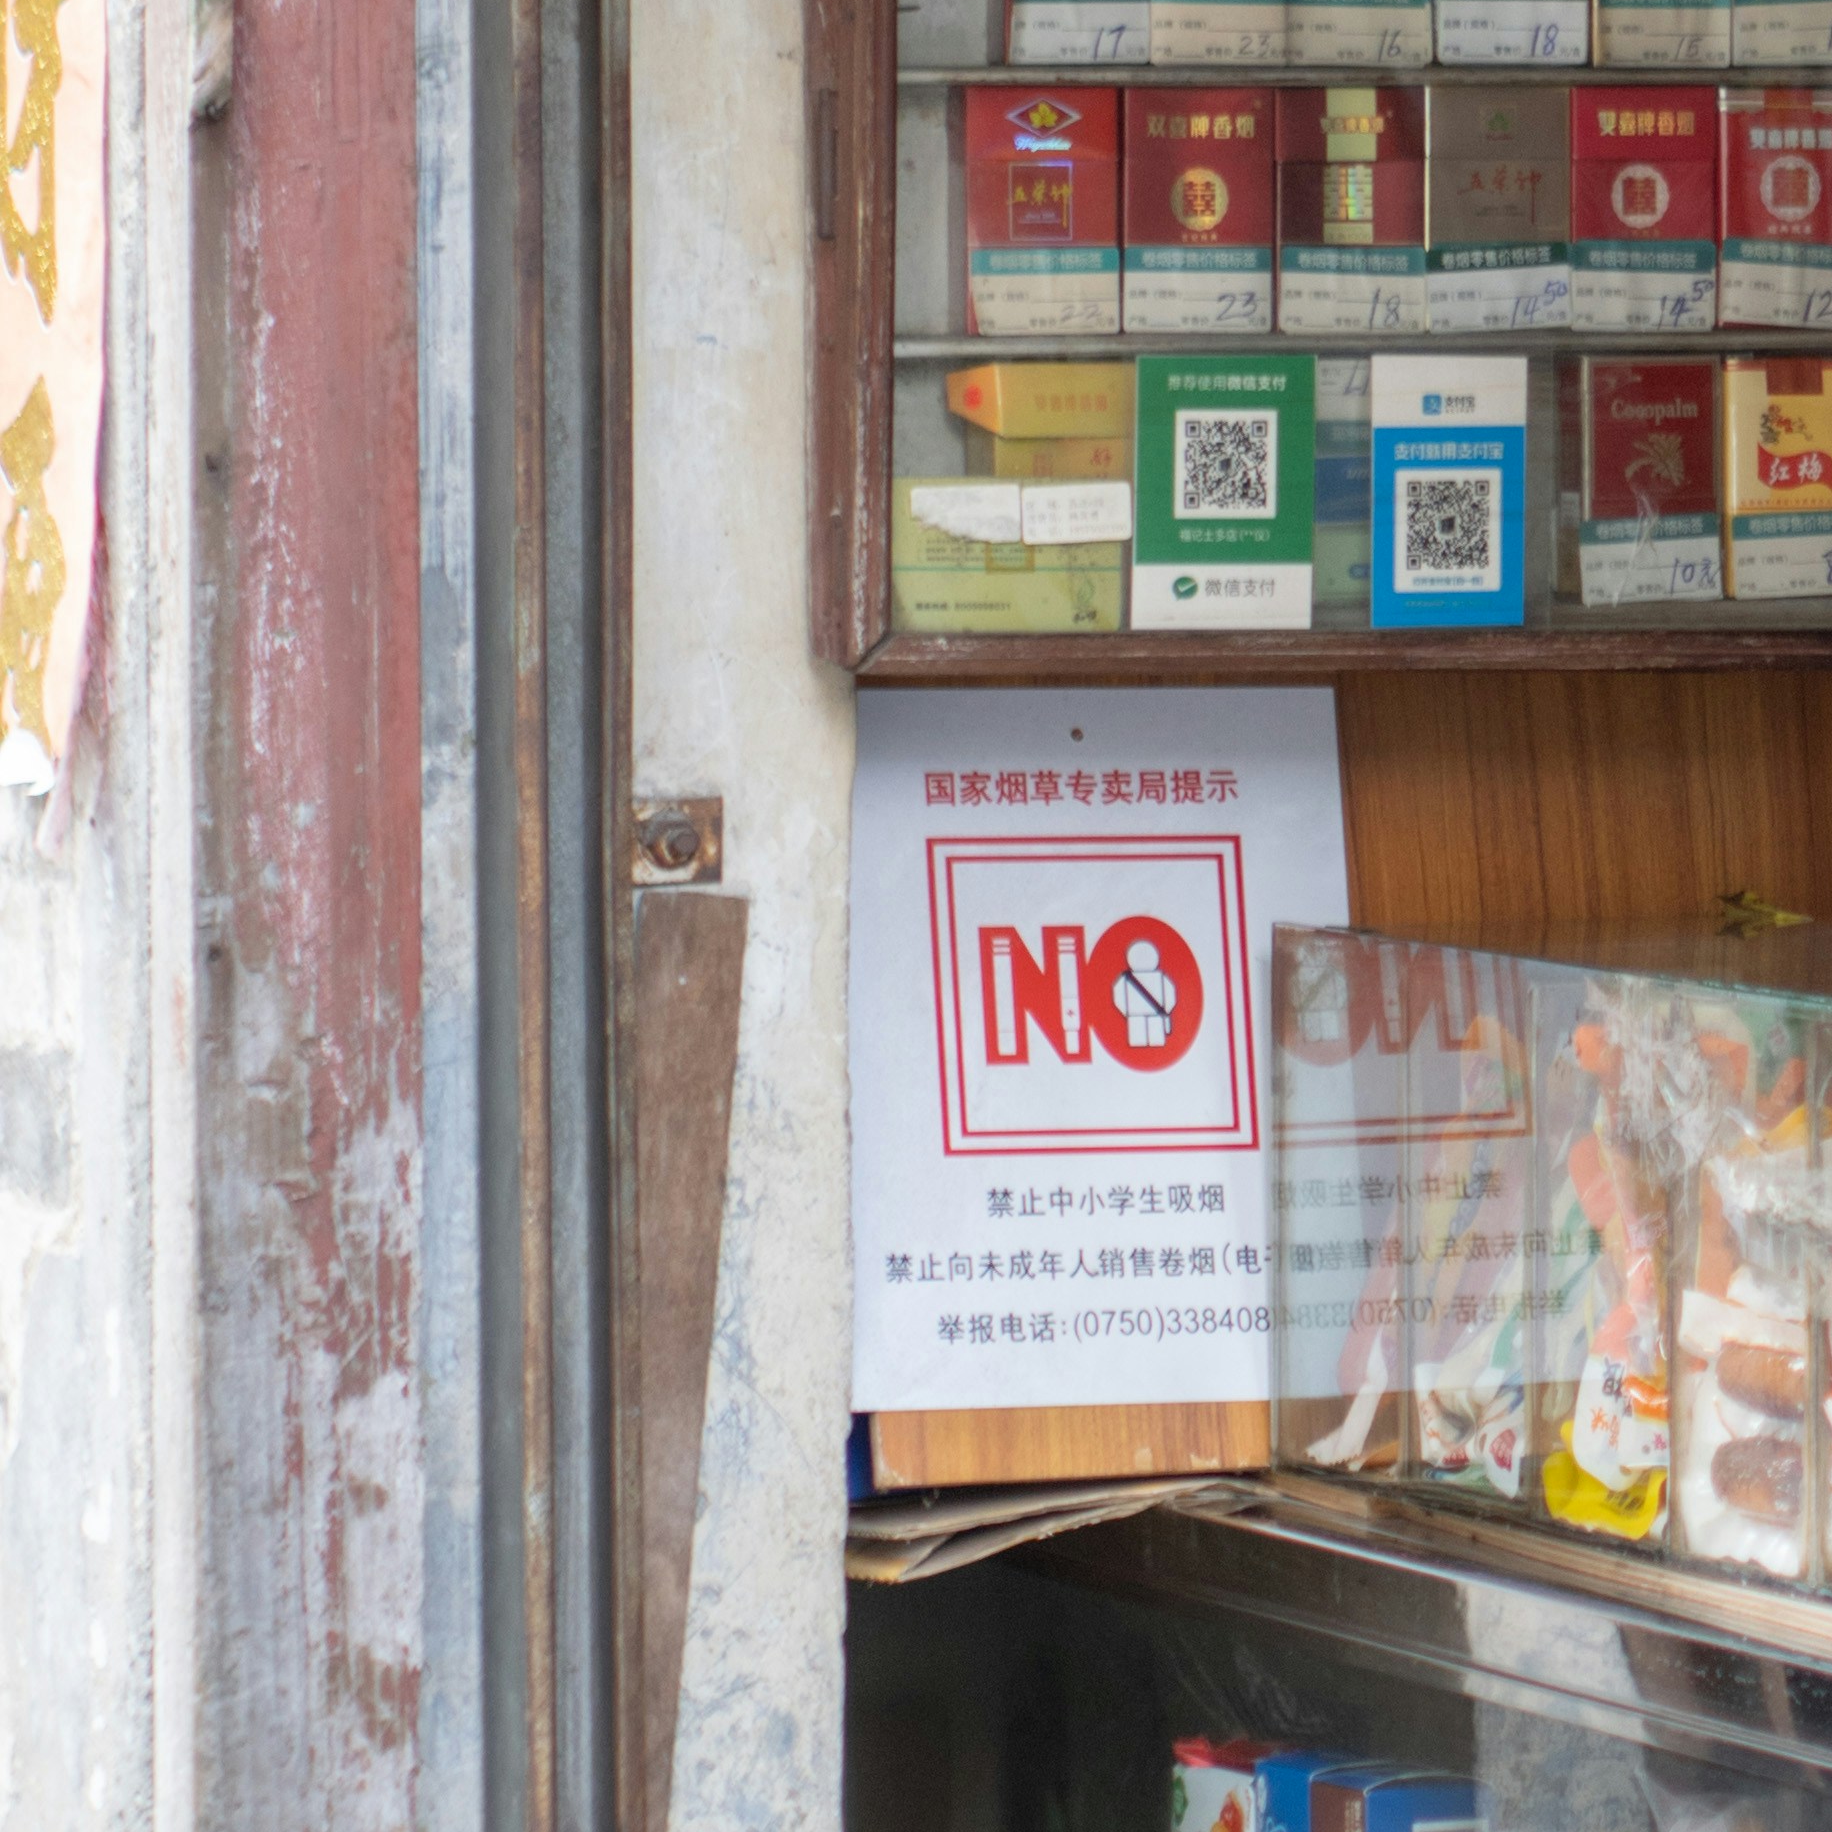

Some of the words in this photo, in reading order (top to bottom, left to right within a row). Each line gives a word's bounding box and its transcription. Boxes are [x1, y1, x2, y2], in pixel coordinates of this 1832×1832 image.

[1094, 25, 1127, 61] 17
[1377, 29, 1401, 62] 16
[1531, 24, 1559, 57] 18
[1216, 291, 1258, 322] 23
[1369, 287, 1401, 331] 18
[1167, 375, 1286, 392] 推荐使用微信支付
[1445, 395, 1476, 408] 支付宝
[1394, 442, 1504, 461] 支付就用支付宝
[1768, 457, 1825, 484] 红梅
[1204, 578, 1276, 598] 微信支付
[924, 769, 1240, 807] 国家烟草专卖局提示
[978, 915, 1204, 1073] NO
[986, 1183, 1227, 1219] 禁止中小学生吸烟
